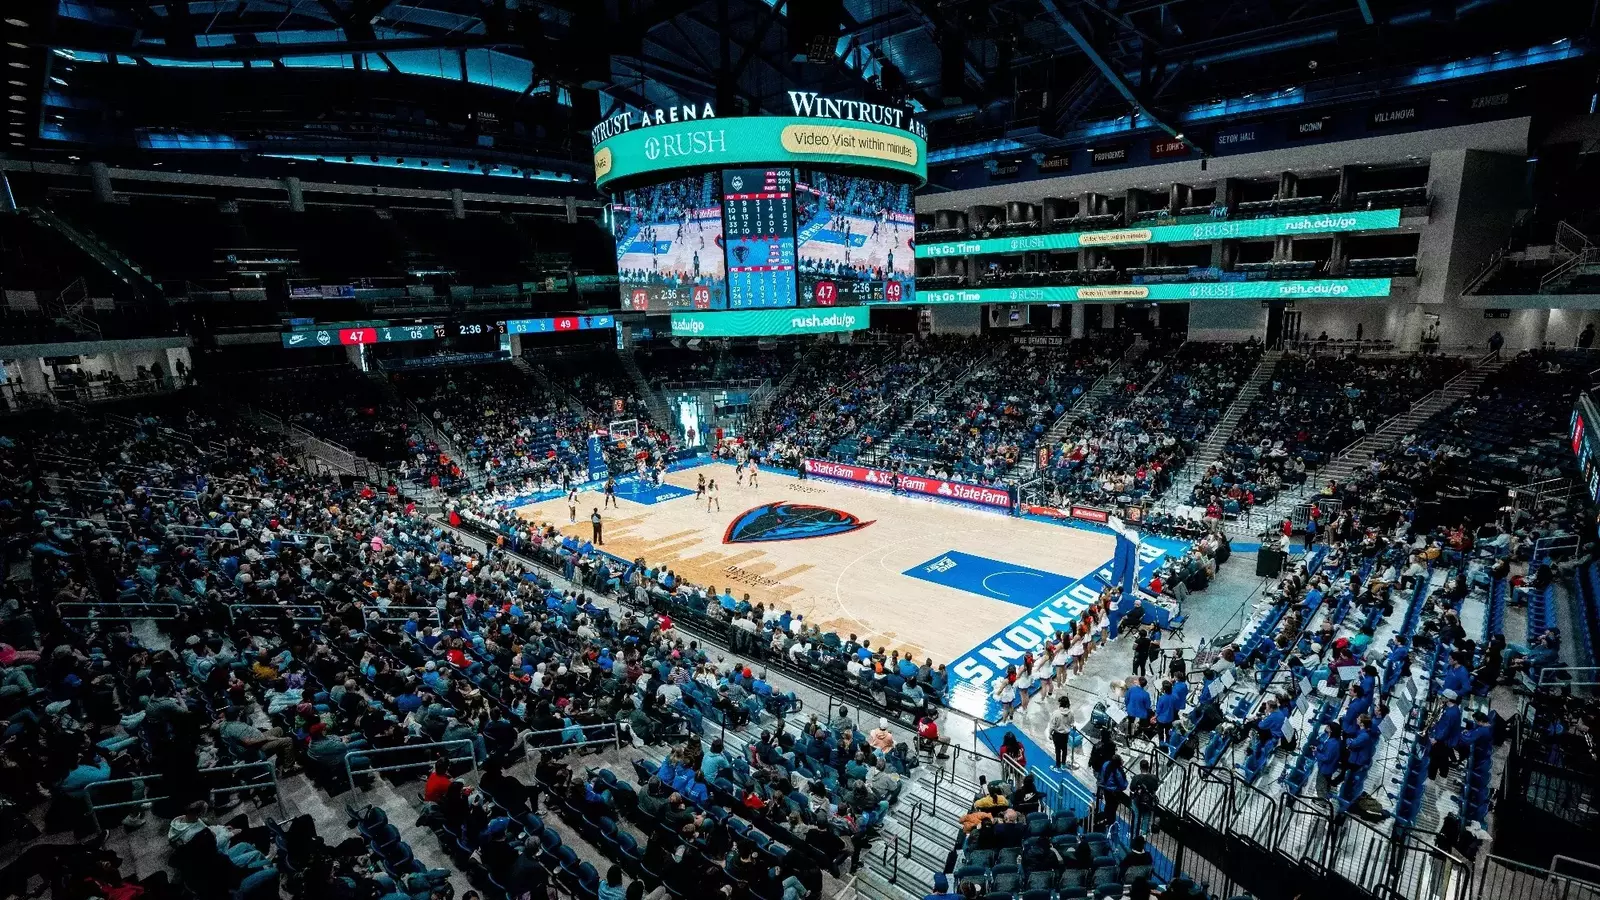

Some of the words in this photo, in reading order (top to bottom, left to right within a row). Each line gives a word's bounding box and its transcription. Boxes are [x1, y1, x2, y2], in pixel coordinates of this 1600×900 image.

[641, 102, 715, 127] ARENA
[787, 90, 904, 128] WINTRUST
[1374, 108, 1415, 122] VILLANOVA
[1299, 121, 1322, 133] UCONN
[663, 130, 727, 158] RUSH
[1218, 134, 1238, 144] SETON
[1239, 132, 1256, 142] HALL
[794, 132, 830, 146] Video
[832, 134, 856, 148] Visit
[858, 137, 885, 152] within
[886, 142, 912, 158] minutes
[1156, 144, 1164, 152] ST.
[1165, 142, 1185, 151] JOHN'S
[1094, 150, 1124, 161] PROVIDENCE
[1285, 214, 1356, 230] rush.edu/go
[1204, 224, 1240, 237] RUSH
[927, 246, 940, 255] It's
[942, 245, 955, 254] Go
[956, 244, 981, 253] Time
[1019, 239, 1045, 248] RUSH
[818, 286, 832, 298] 47
[852, 282, 870, 293] 2:36
[887, 285, 900, 296] 49
[1018, 290, 1044, 300] RUSH
[1201, 286, 1236, 297] RUSH
[1280, 283, 1348, 295] rush.edu/go
[633, 293, 645, 304] 47
[660, 290, 678, 300] 2:36
[694, 290, 709, 302] 49
[927, 292, 941, 302] It's
[942, 292, 955, 301] Go
[956, 291, 980, 301] Time
[560, 320, 571, 328] 49
[792, 312, 855, 328] rush.edu/go
[411, 330, 422, 339] 05
[436, 329, 446, 337] 12
[459, 324, 482, 335] 2:36
[350, 331, 364, 342] 47
[385, 332, 392, 340] 4
[954, 583, 1101, 686] DEMONS
